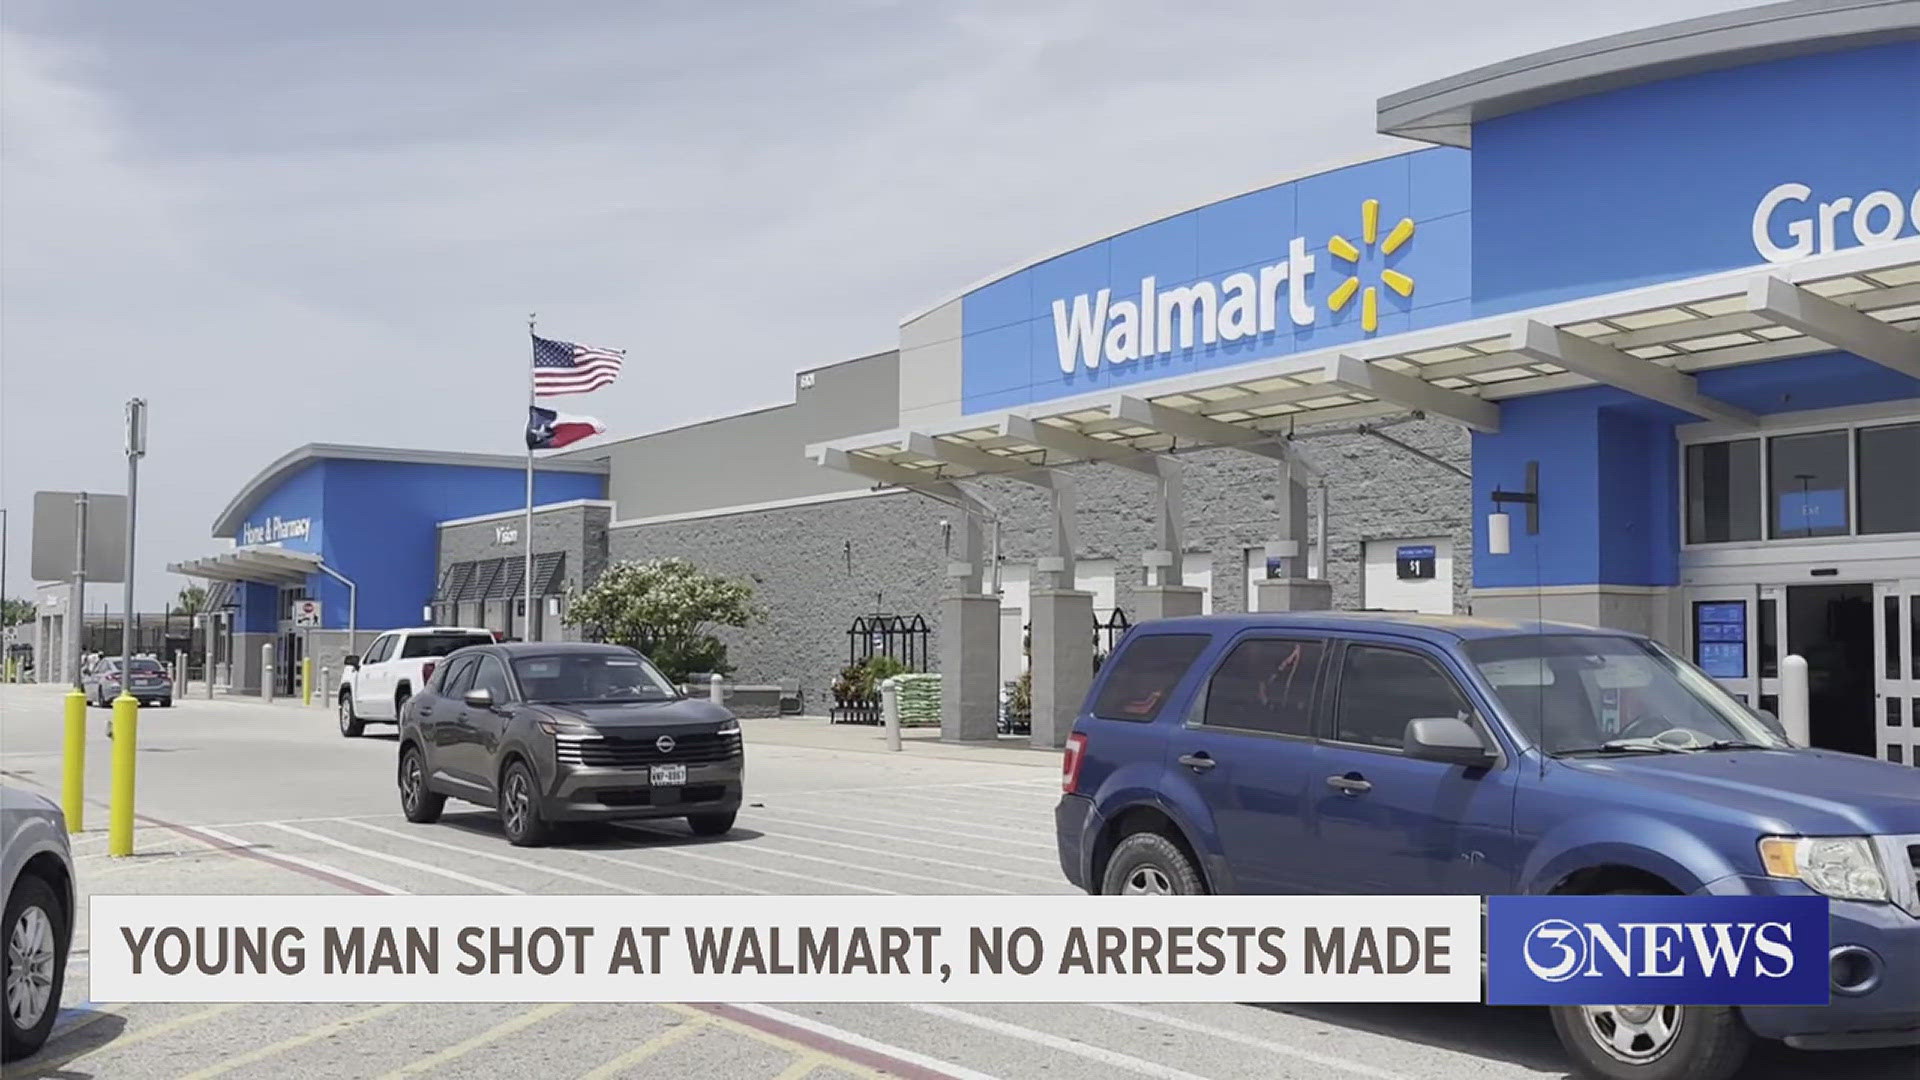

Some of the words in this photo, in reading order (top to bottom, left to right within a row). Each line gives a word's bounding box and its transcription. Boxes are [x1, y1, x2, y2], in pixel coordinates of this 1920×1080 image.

[1053, 237, 1314, 374] Walmart
[243, 521, 264, 545] Home
[265, 517, 272, 541] &
[273, 516, 311, 543] Pharmacy
[496, 526, 517, 543] Vision
